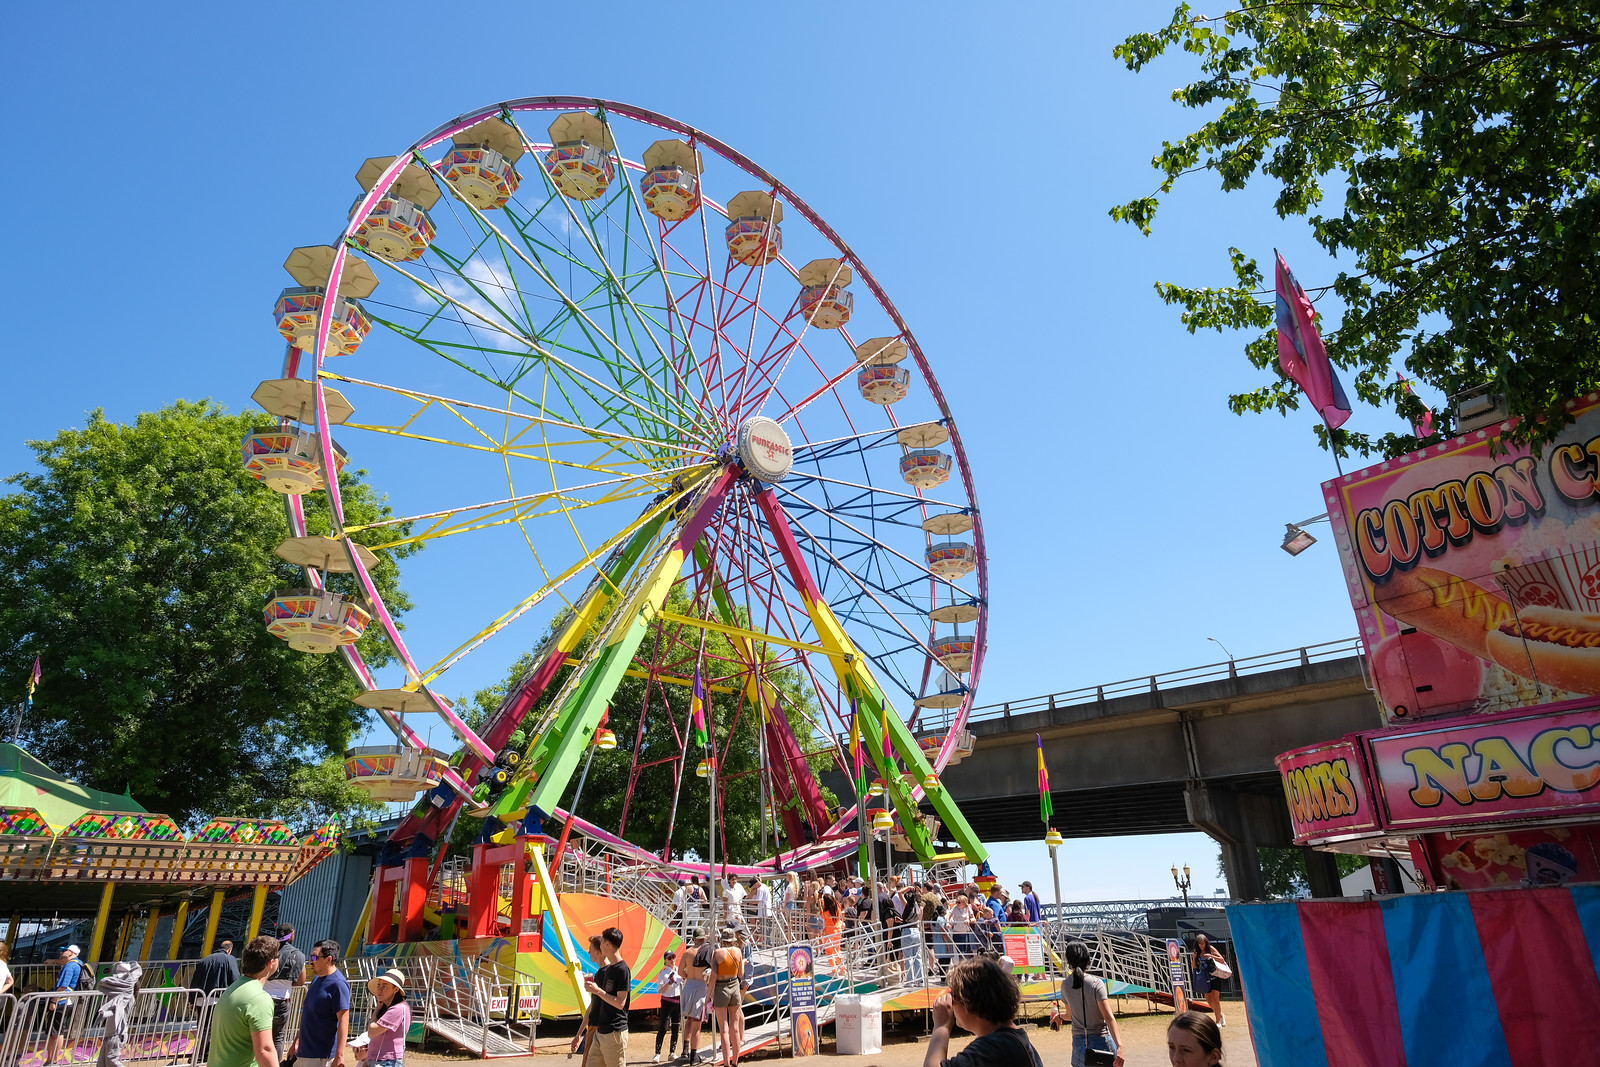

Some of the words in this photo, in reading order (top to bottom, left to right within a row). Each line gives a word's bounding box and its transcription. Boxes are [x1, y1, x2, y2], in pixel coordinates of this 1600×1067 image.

[752, 435, 789, 456] FUNTASTIC
[1356, 456, 1546, 583] COTTON
[1288, 757, 1358, 824] CONES
[1402, 723, 1600, 808] NAC
[492, 999, 507, 1009] EXIT
[519, 999, 538, 1009] ONLY
